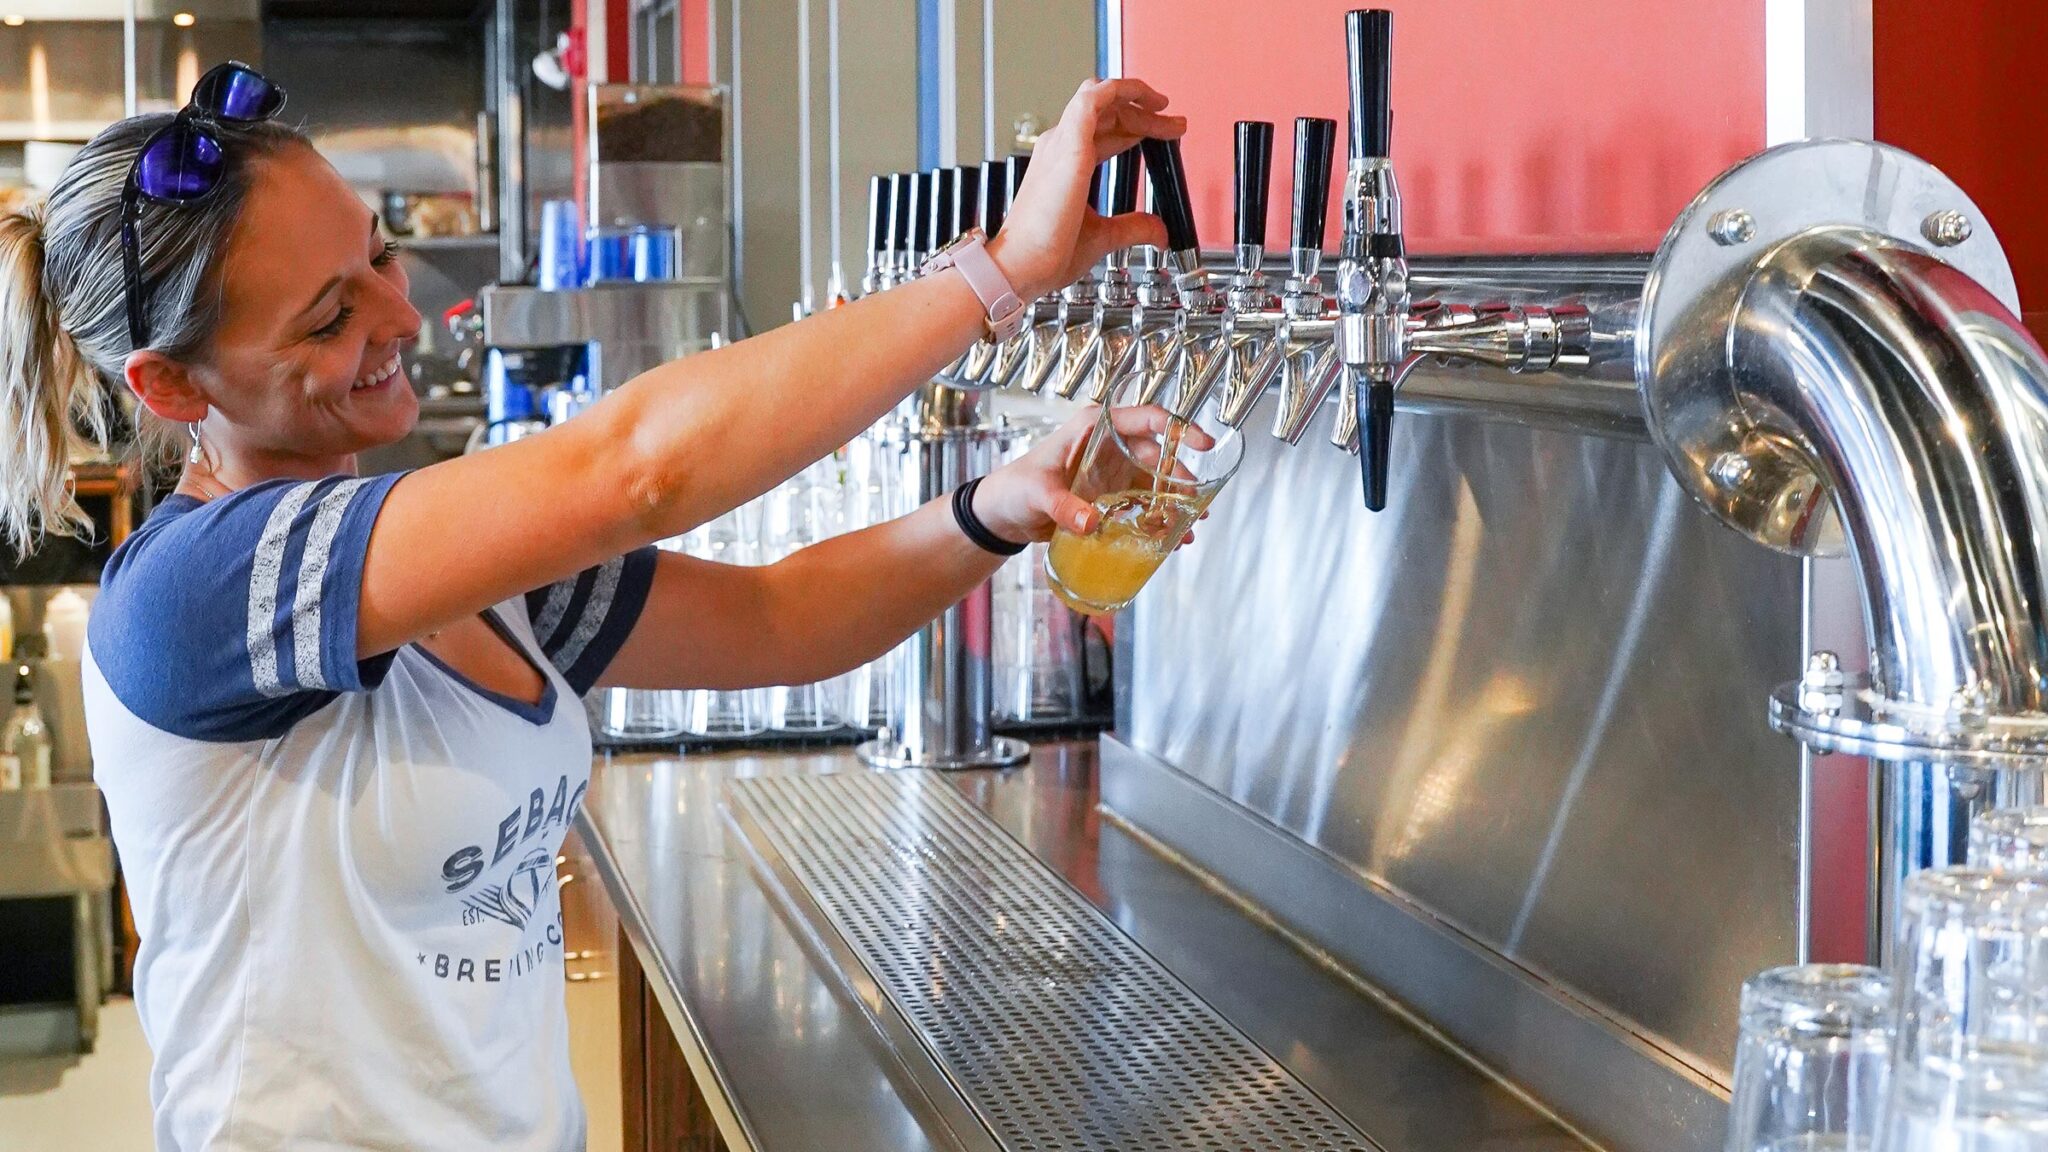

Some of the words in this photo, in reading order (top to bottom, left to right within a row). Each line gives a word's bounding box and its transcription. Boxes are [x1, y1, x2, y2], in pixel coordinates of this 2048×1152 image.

[462, 908, 485, 927] EST.
[434, 942, 544, 983] BREING
[546, 911, 563, 945] C
